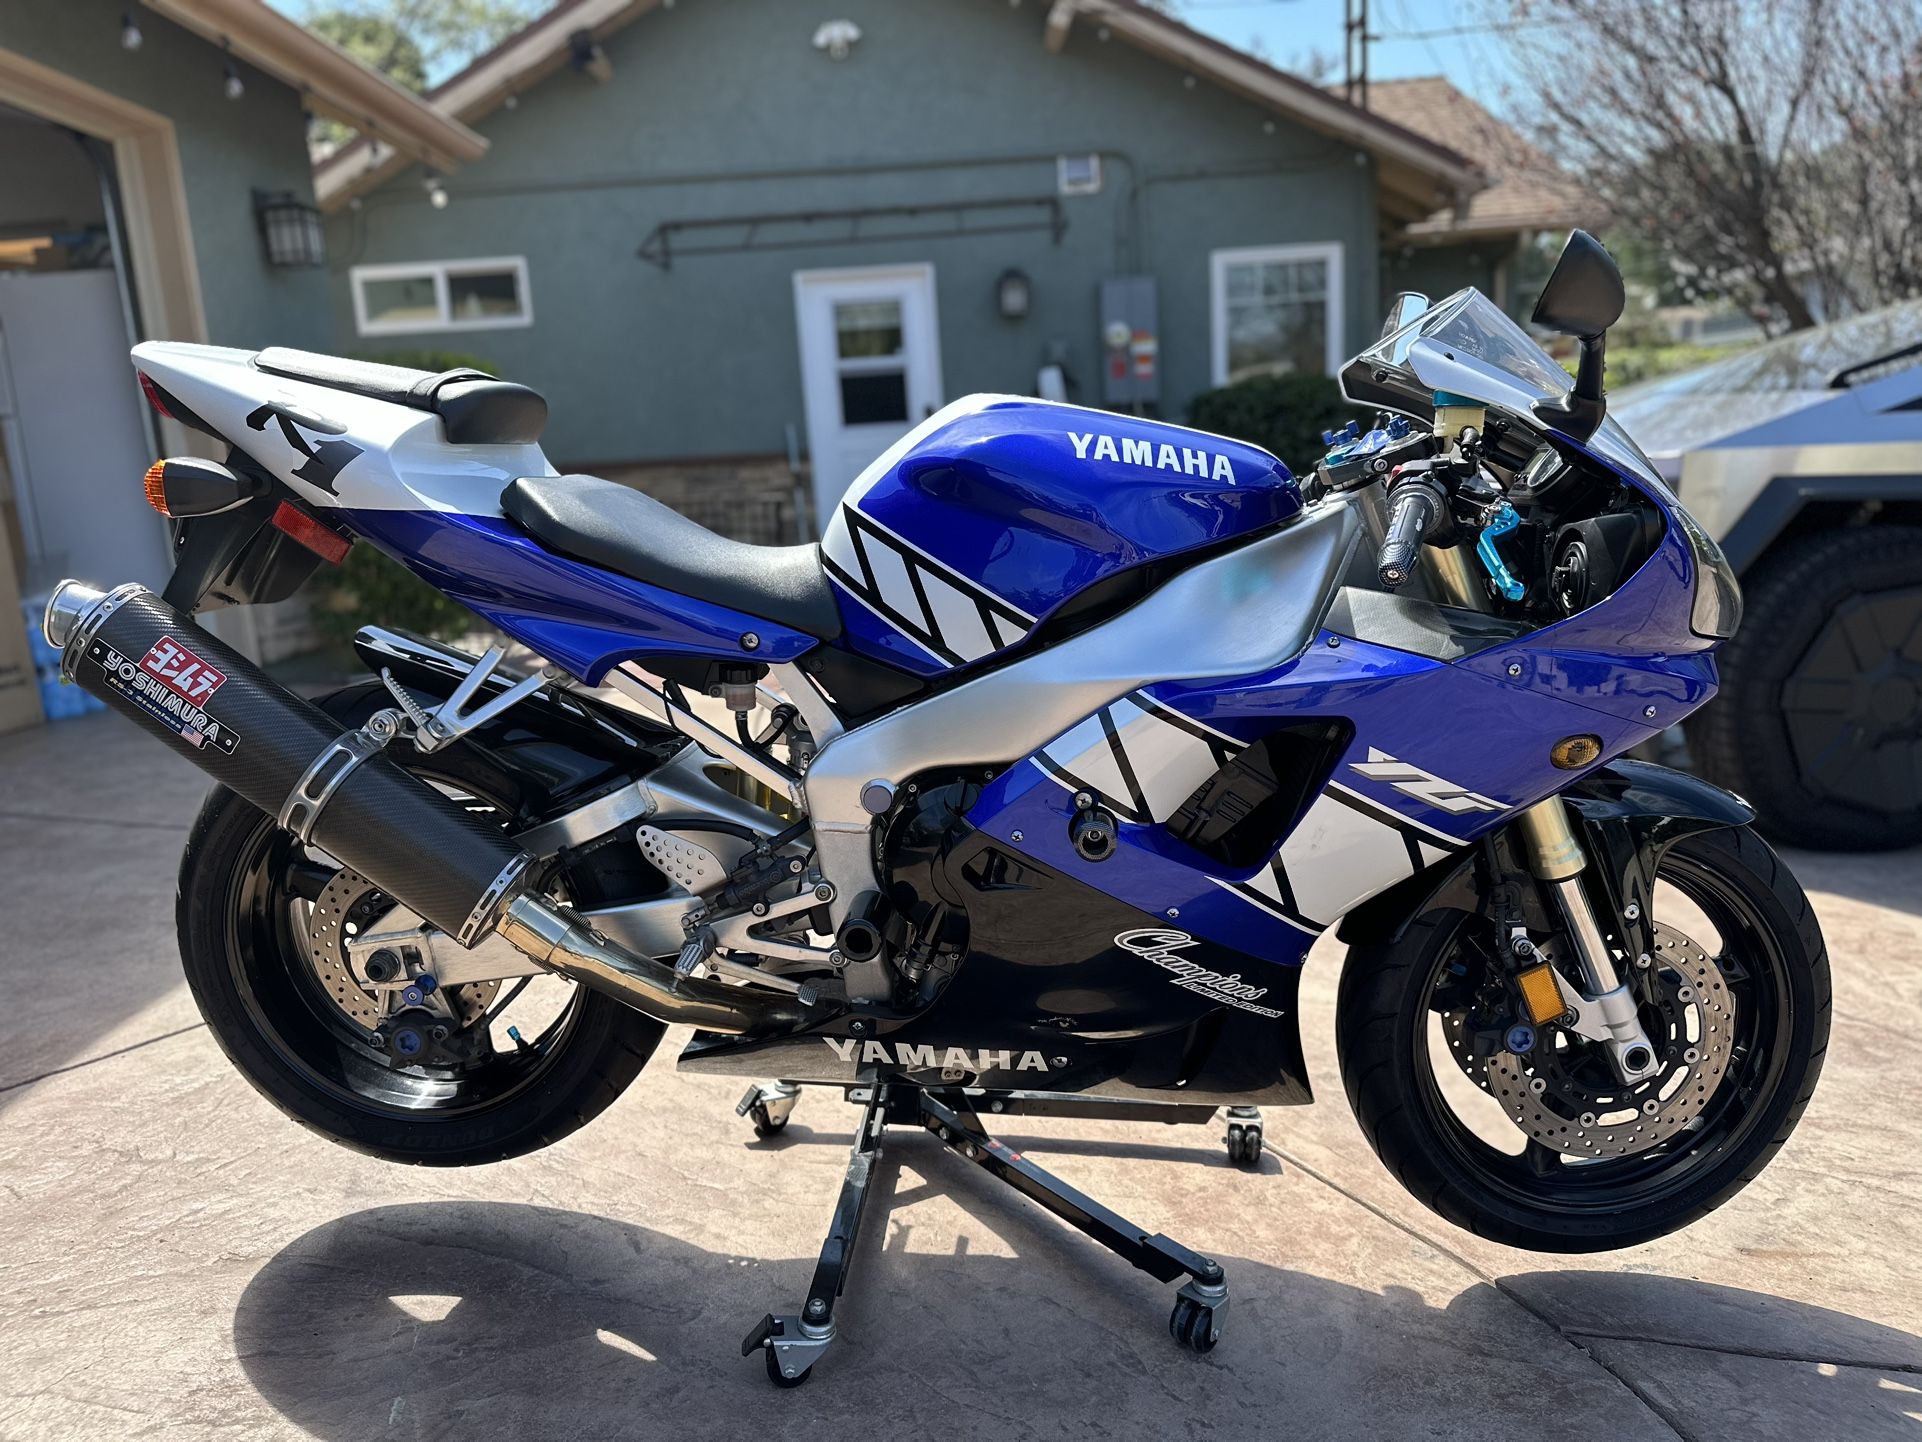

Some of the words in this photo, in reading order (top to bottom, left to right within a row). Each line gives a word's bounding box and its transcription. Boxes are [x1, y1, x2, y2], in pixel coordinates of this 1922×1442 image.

[1067, 431, 1236, 486] YAMAHA
[103, 651, 219, 741] YOSHIMURA
[148, 643, 218, 697] ヨシムラ
[1113, 928, 1268, 1000] Champions
[823, 1037, 1049, 1072] YAMAHA
